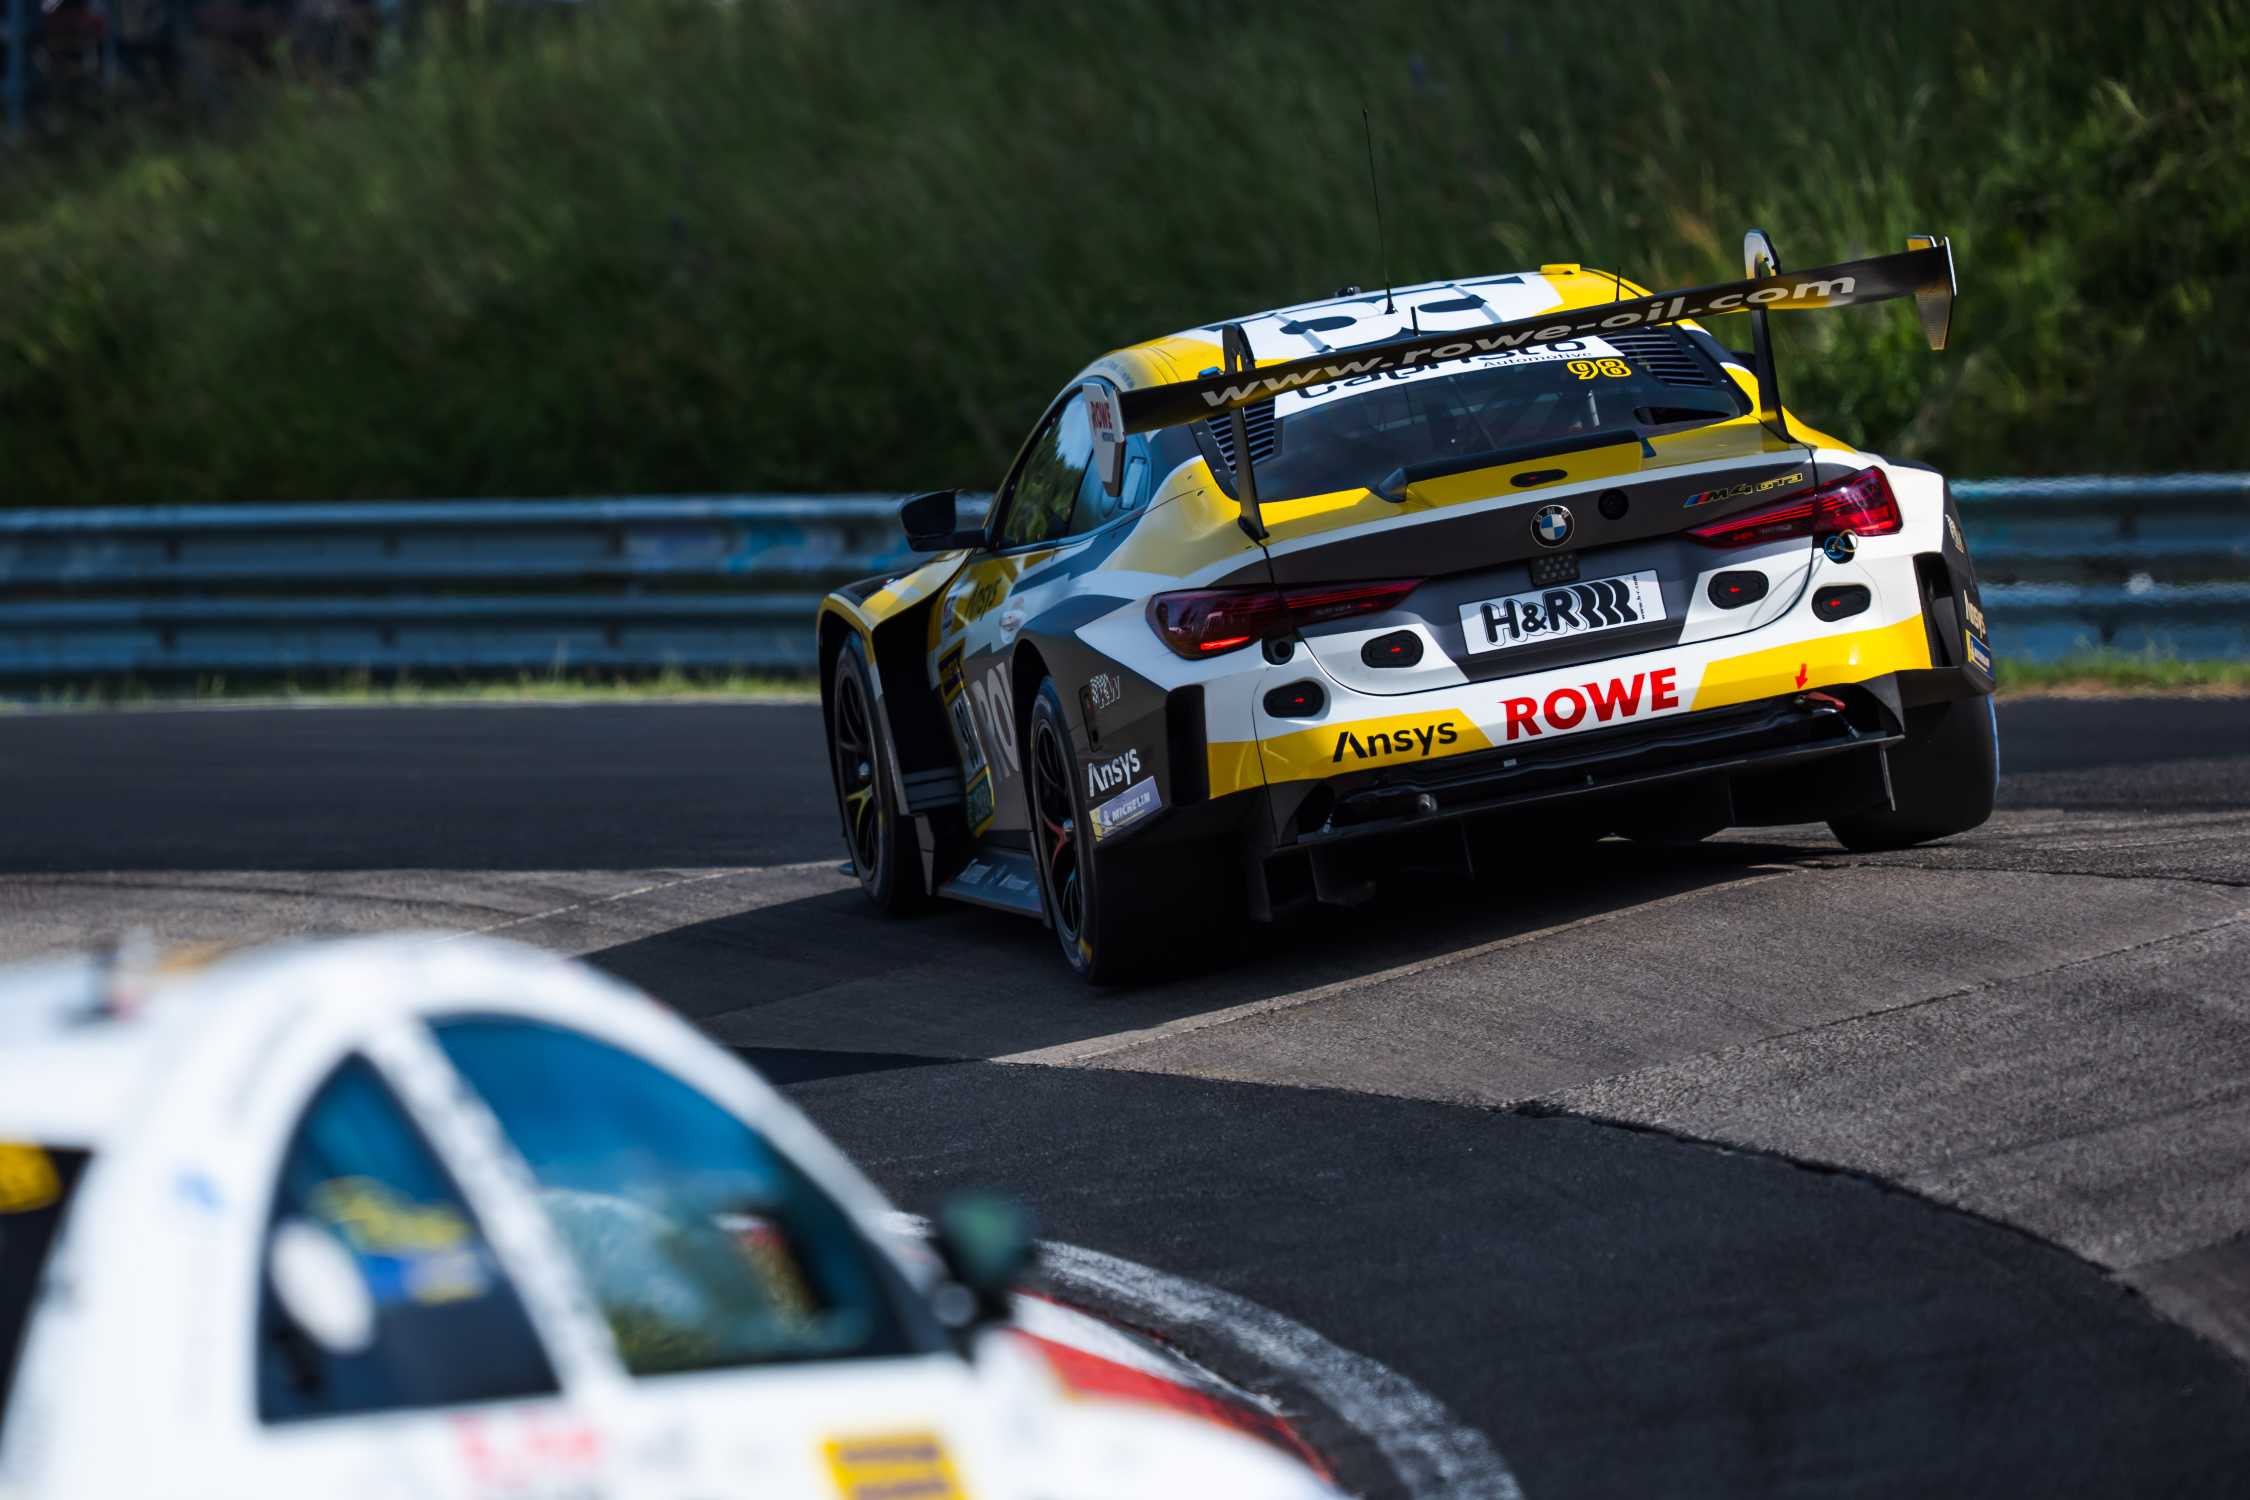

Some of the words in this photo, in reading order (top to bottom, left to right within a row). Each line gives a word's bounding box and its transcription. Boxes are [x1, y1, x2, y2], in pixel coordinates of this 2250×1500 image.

[1567, 358, 1632, 380] 98
[1498, 667, 1680, 741] ROWE
[1333, 721, 1457, 763] Ansys
[1087, 748, 1141, 798] Ansys
[1111, 791, 1151, 823] MICHELIN
